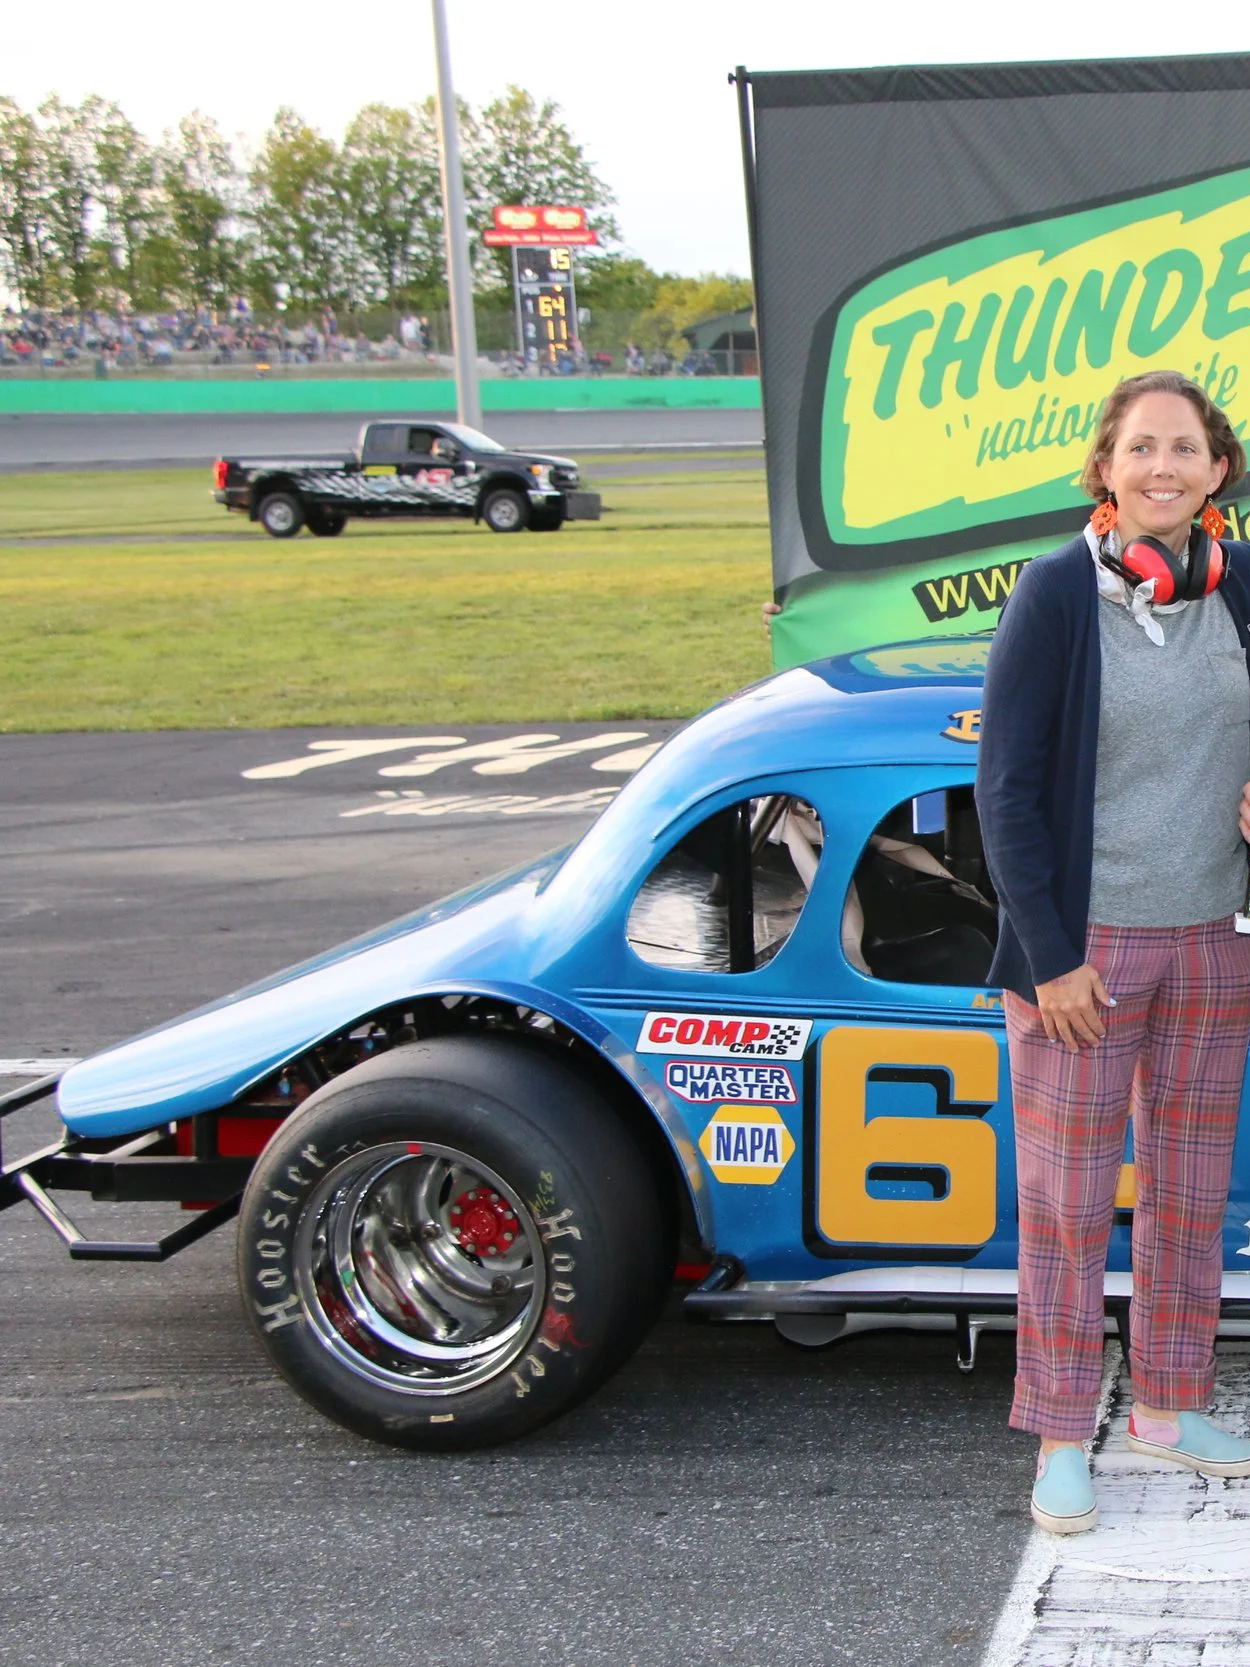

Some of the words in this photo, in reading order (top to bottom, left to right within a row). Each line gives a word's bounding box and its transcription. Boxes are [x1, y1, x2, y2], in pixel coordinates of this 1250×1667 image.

[550, 248, 571, 270] 15
[538, 296, 566, 317] 64
[1190, 352, 1238, 408] ite
[648, 1017, 771, 1047] COMP
[729, 1042, 788, 1055] CAMS
[668, 1063, 785, 1089] QUARTER
[689, 1080, 791, 1101] MASTER
[715, 1125, 779, 1164] NAPA
[808, 1026, 1000, 1260] 6
[257, 1143, 328, 1334] Hoosier
[511, 1207, 583, 1398] Hooier
